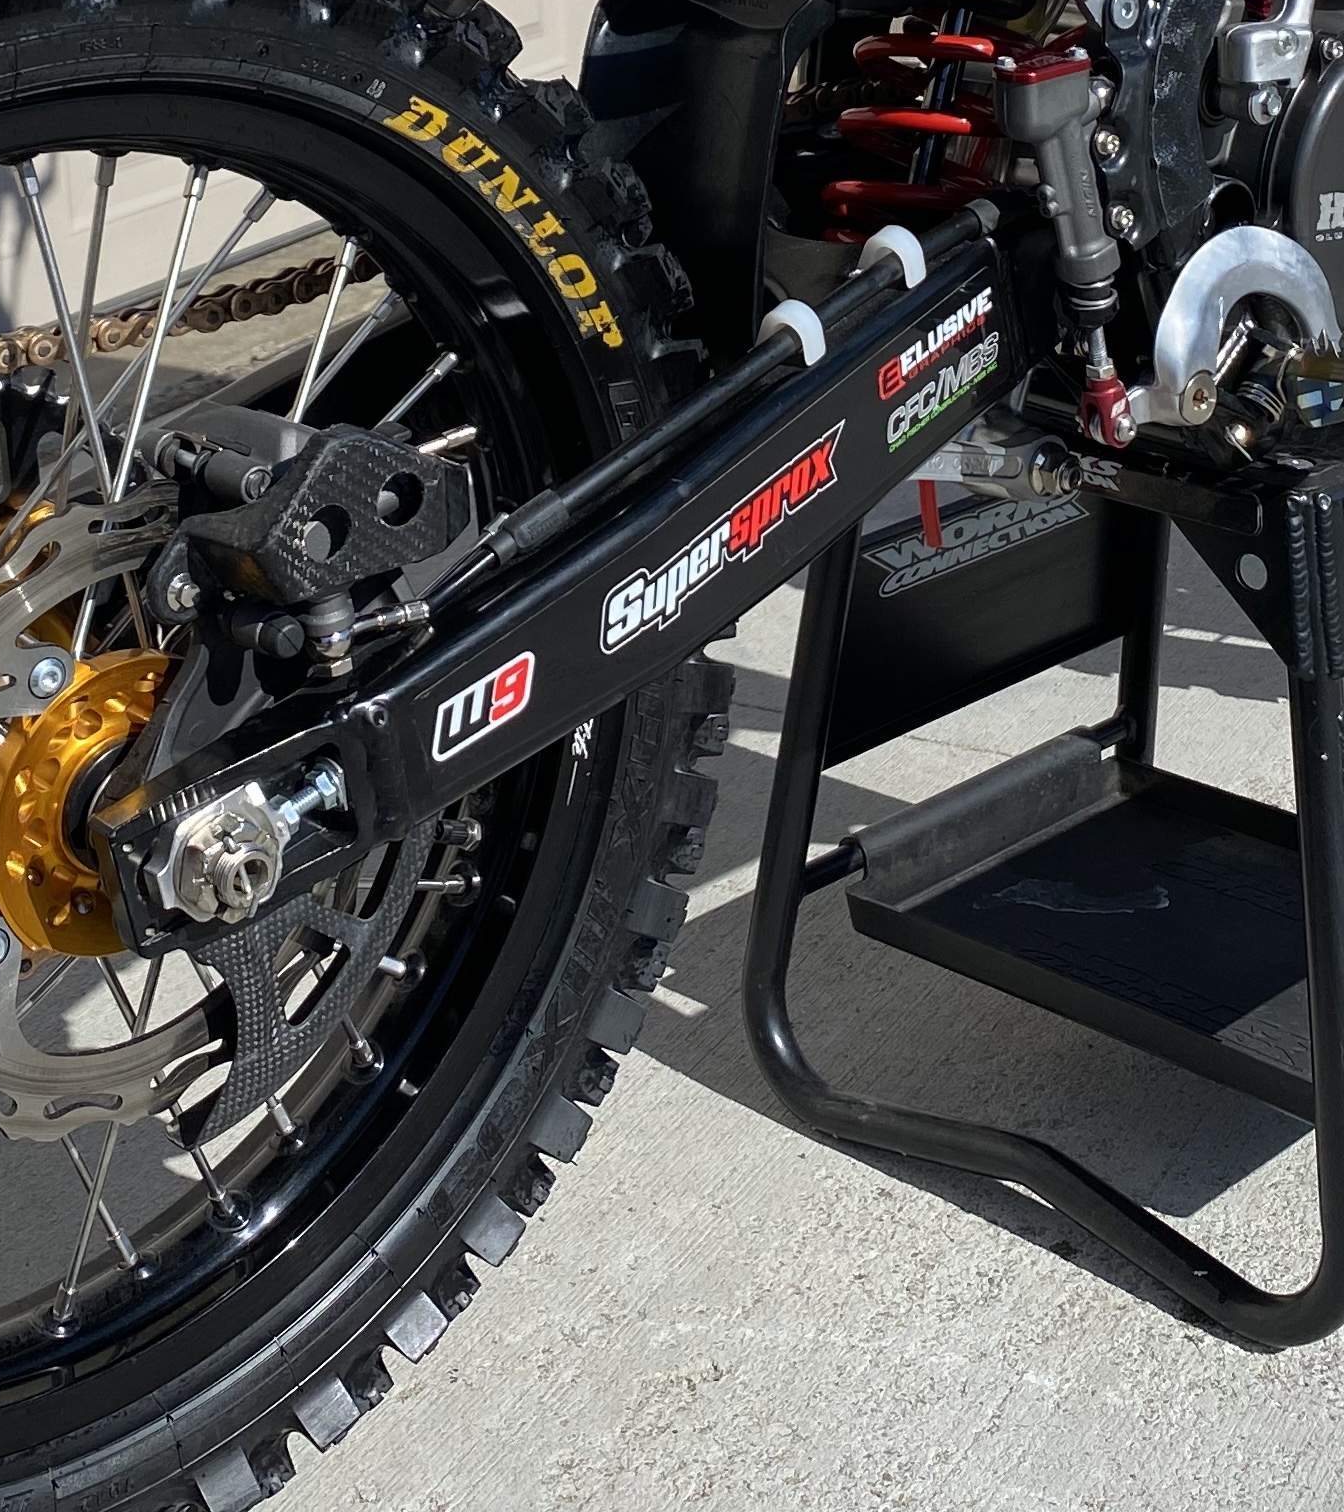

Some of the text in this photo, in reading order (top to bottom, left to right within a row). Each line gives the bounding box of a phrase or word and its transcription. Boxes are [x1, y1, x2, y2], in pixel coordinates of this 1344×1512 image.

[383, 94, 623, 348] DUNLOP
[887, 331, 1000, 444] CFC/MBS
[899, 286, 994, 376] ELUSIVE
[606, 438, 835, 648] Supersprox
[887, 504, 1082, 590] CONNECTION
